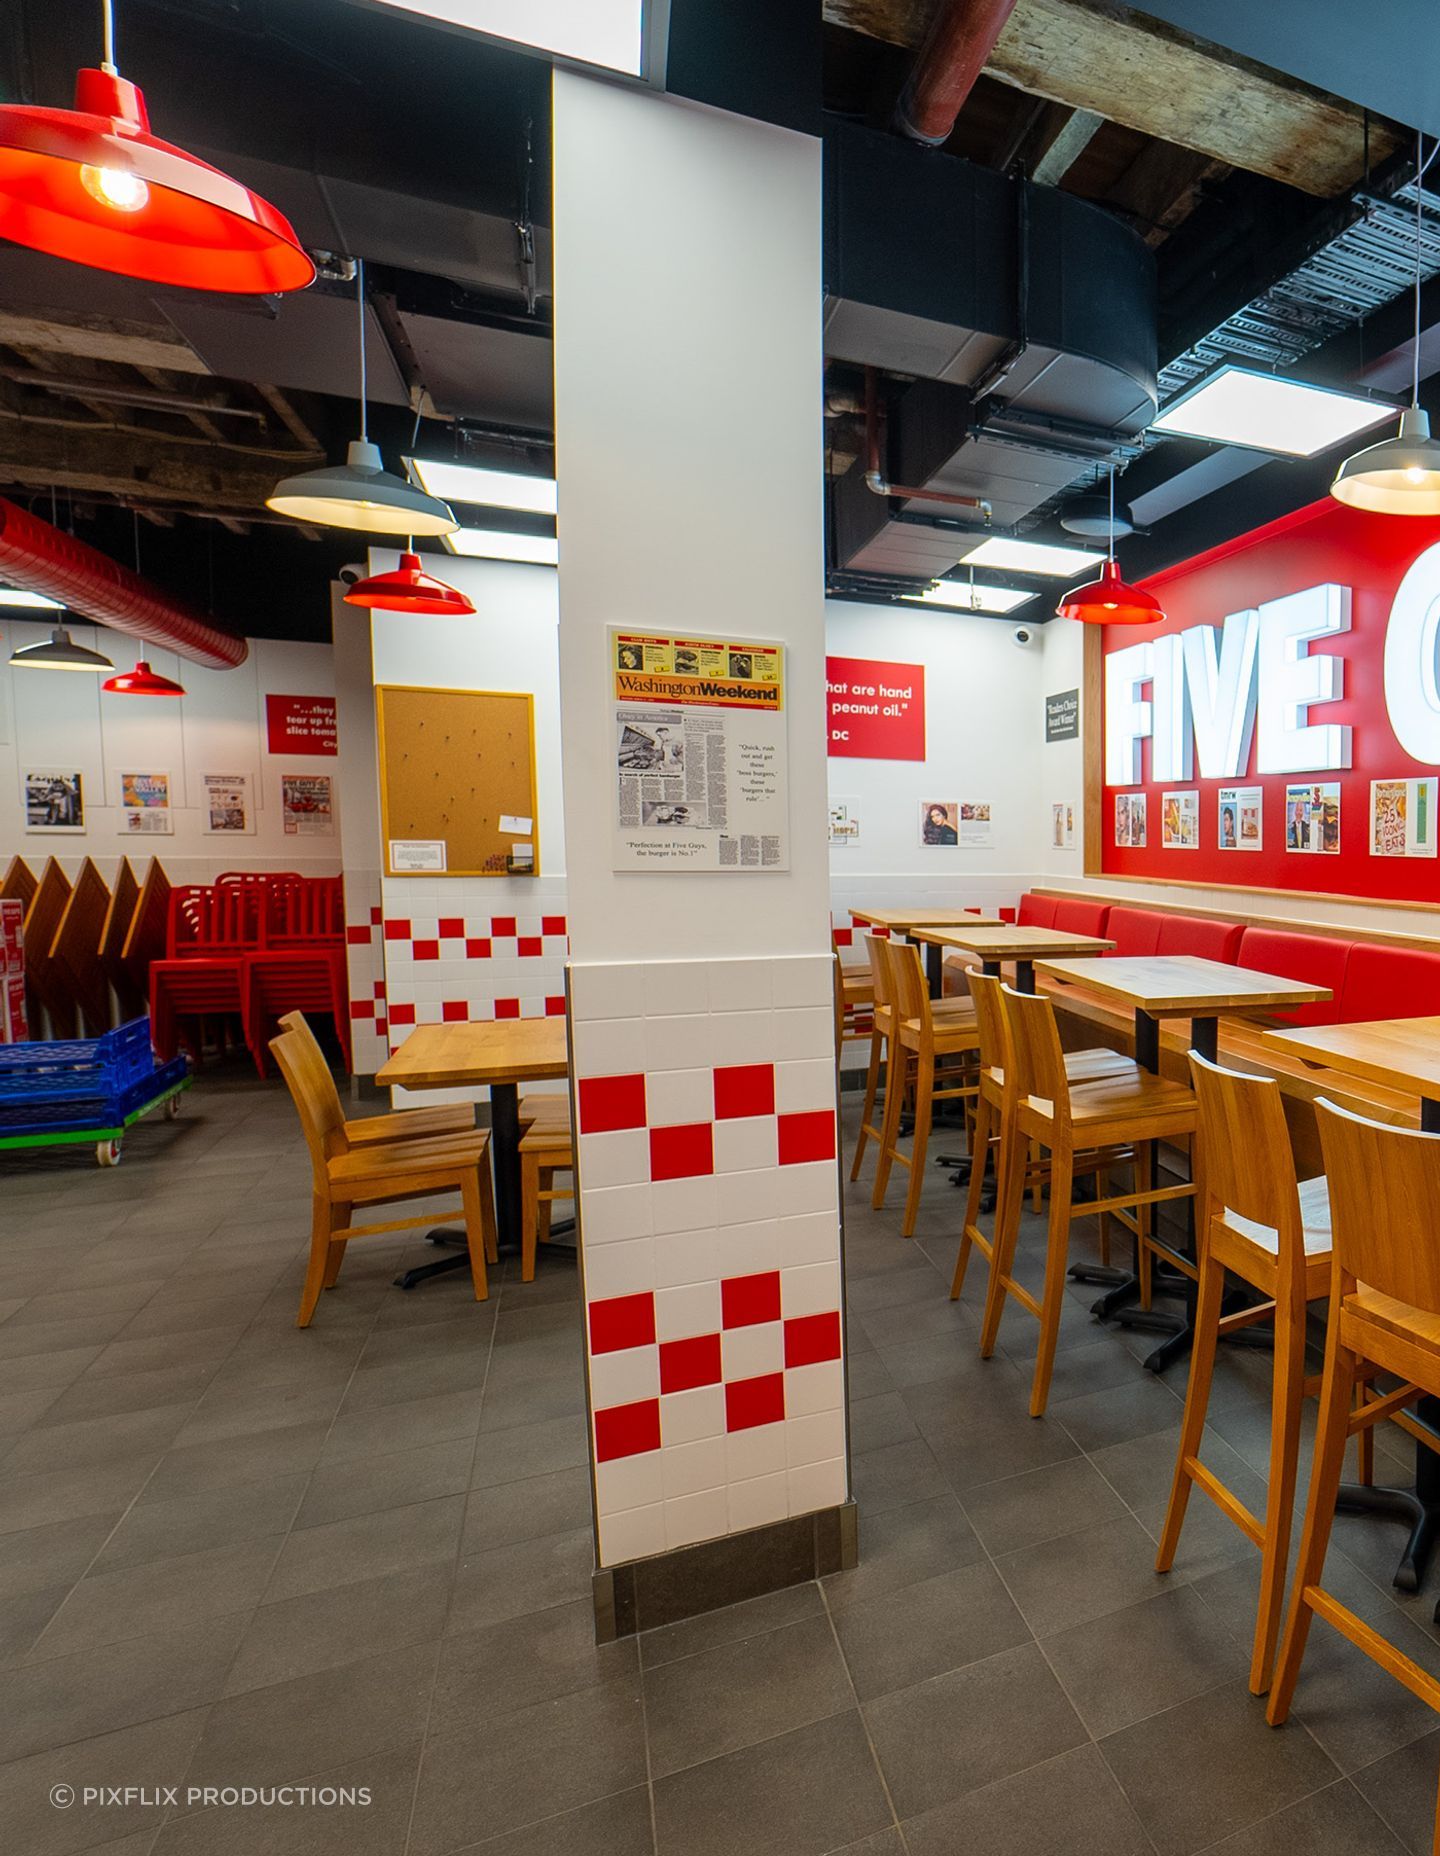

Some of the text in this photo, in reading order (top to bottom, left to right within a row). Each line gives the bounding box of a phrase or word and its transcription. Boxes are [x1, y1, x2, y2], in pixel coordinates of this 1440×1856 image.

[618, 675, 778, 701] WashingtonWeekend
[852, 685, 875, 696] are
[879, 684, 912, 699] hand
[1105, 583, 1352, 786] FIVE
[832, 703, 908, 717] peanut oil."
[286, 716, 307, 724] tear
[310, 718, 323, 727] up
[286, 726, 309, 735] slice
[832, 730, 849, 740] DC
[1384, 809, 1395, 823] 25
[1385, 833, 1406, 851] EATS
